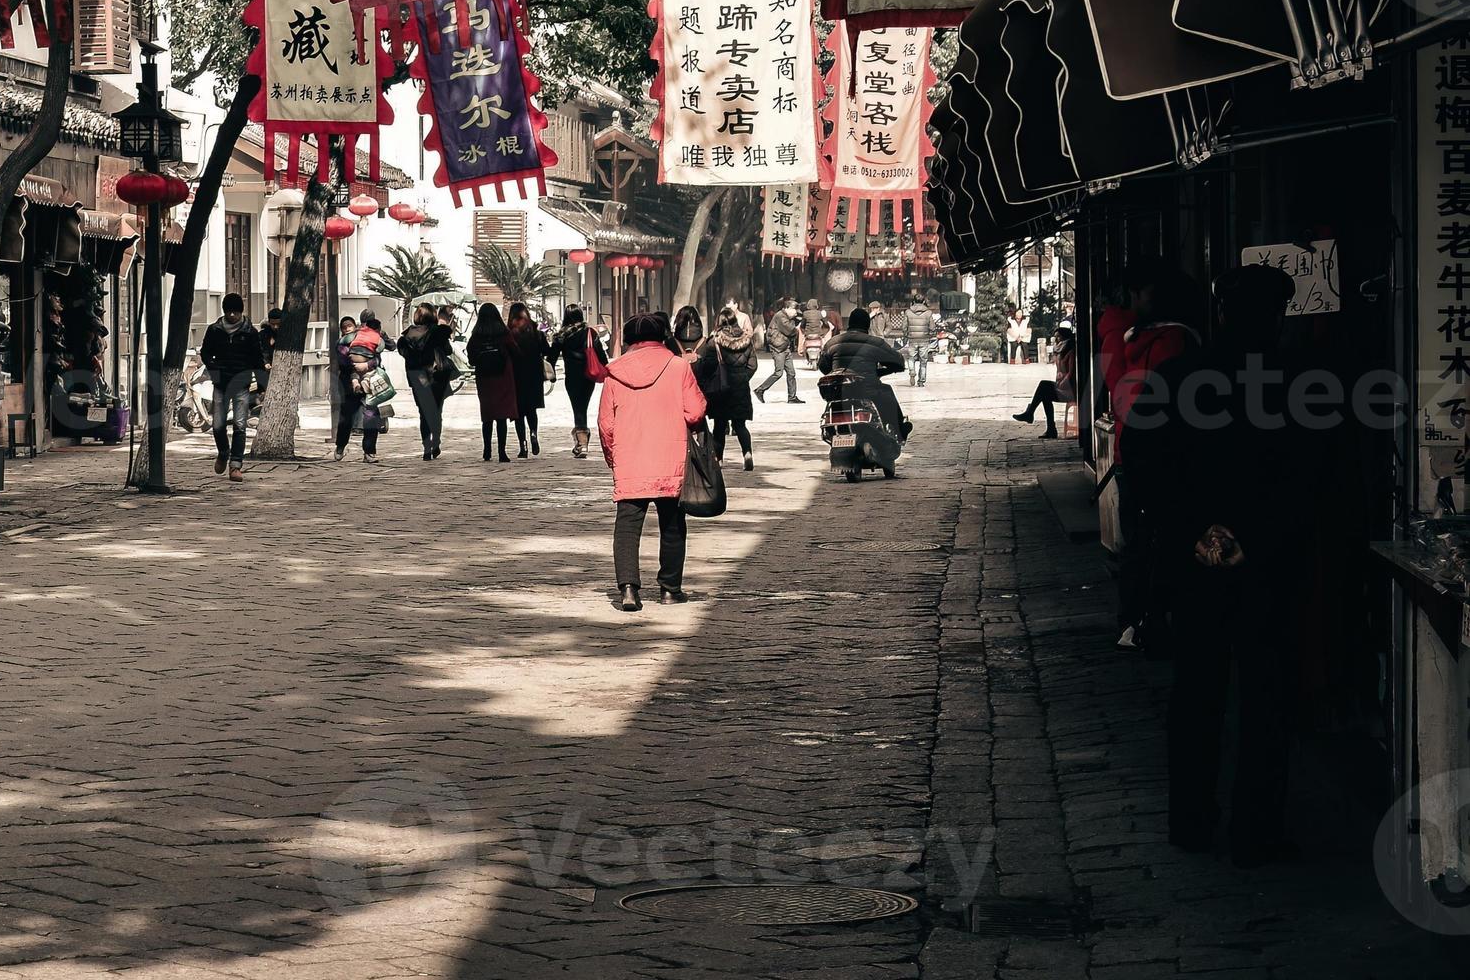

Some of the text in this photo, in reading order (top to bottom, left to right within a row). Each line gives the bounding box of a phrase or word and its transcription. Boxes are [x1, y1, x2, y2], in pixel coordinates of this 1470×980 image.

[270, 82, 373, 105] 苏州拍卖展示点
[861, 28, 898, 156] 复堂客栈
[458, 136, 524, 165] 冰棍
[681, 142, 799, 168] 唯我独尊
